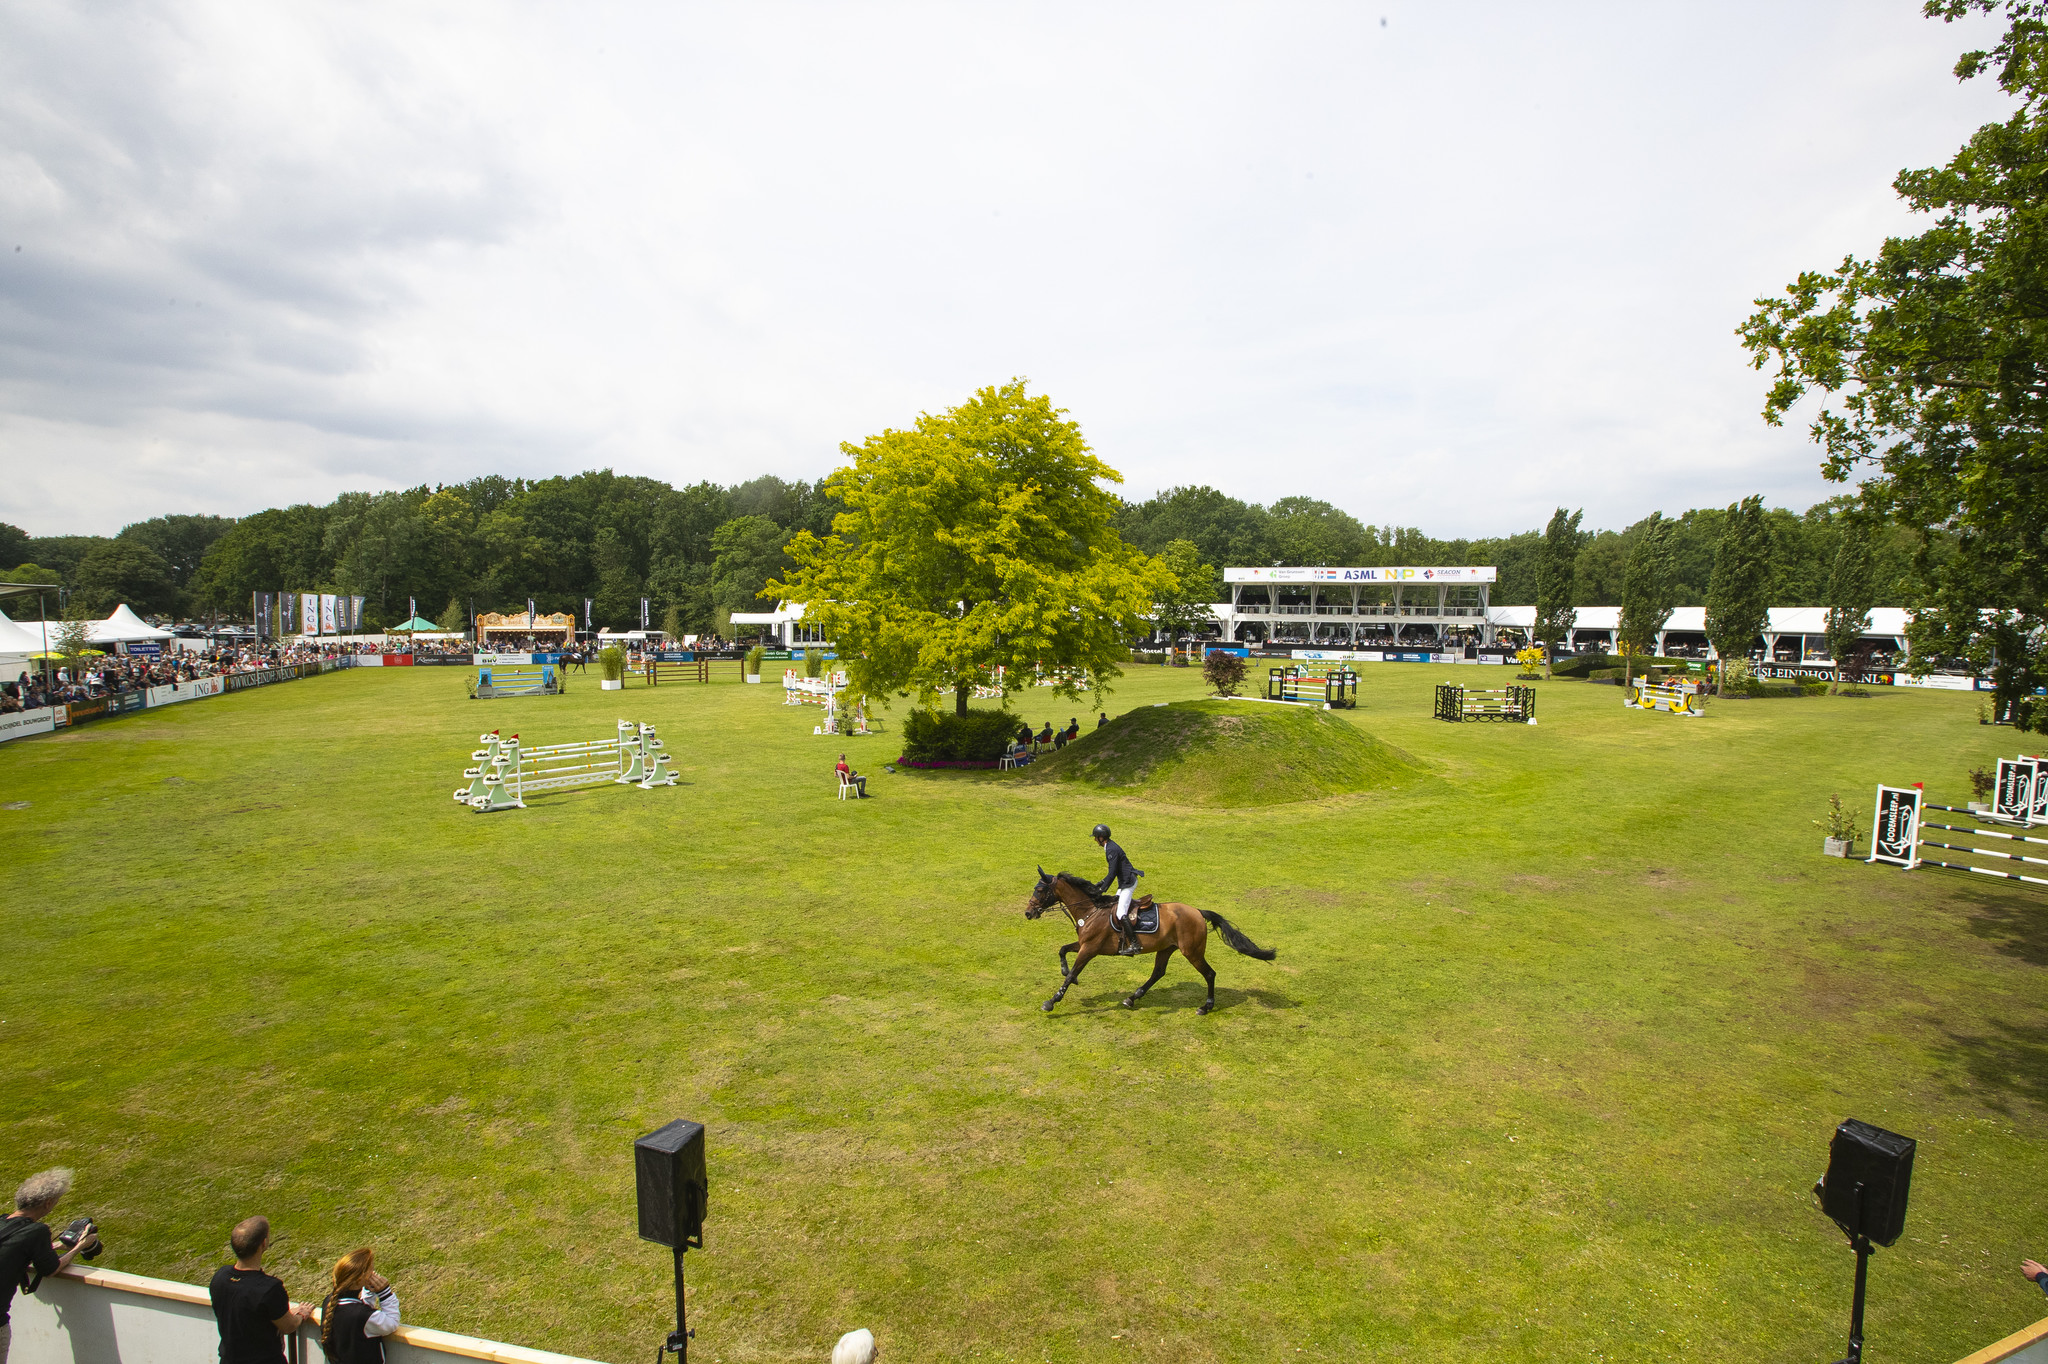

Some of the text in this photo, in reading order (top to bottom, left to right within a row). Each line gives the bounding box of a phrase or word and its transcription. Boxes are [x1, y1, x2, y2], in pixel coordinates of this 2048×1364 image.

[1344, 570, 1377, 579] ASML
[1385, 569, 1415, 579] NXP
[307, 599, 315, 622] ING
[194, 683, 209, 696] ING
[2005, 764, 2017, 806] BODEMSLEEP.nl
[1886, 792, 1900, 842] BODEMSLEEP.nl
